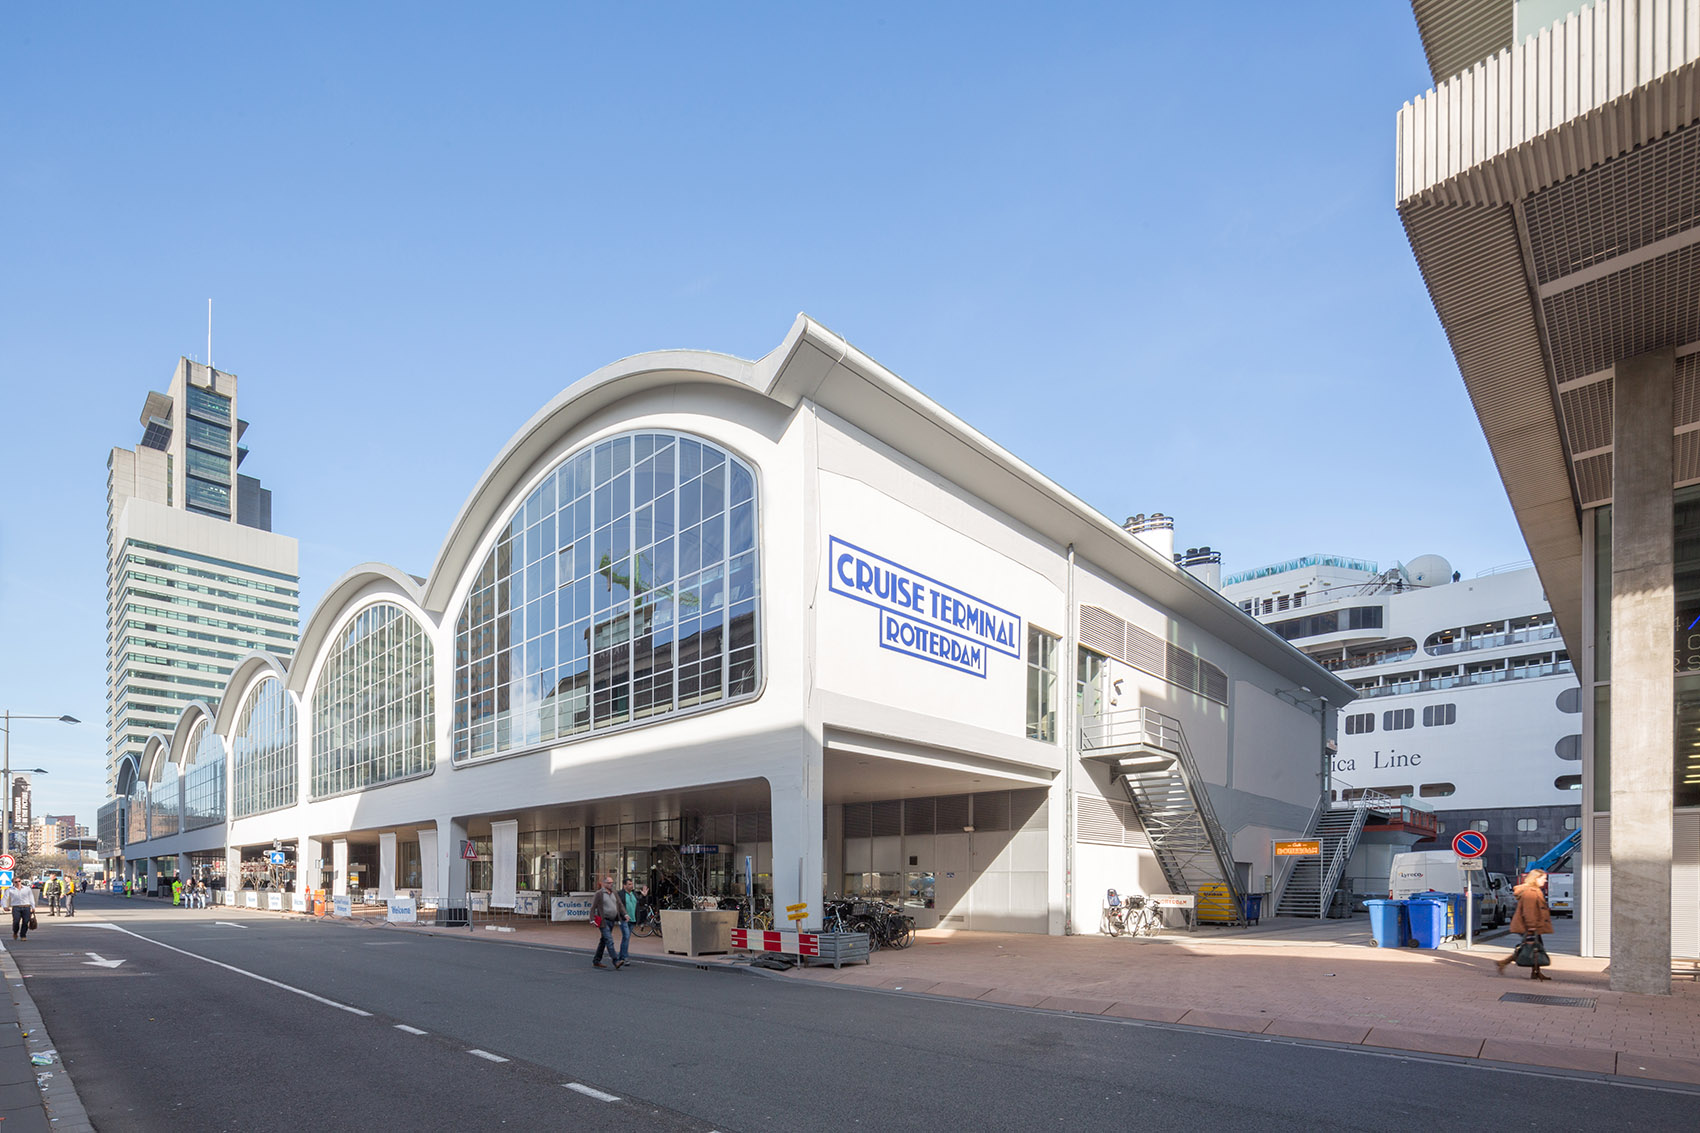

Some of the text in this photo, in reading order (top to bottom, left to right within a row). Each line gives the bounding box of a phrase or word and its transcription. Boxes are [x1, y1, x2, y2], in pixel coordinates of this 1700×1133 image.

[837, 553, 1015, 648] CRUISE TERMINAL
[886, 616, 981, 669] ROTTERDAM
[1374, 749, 1421, 769] Line
